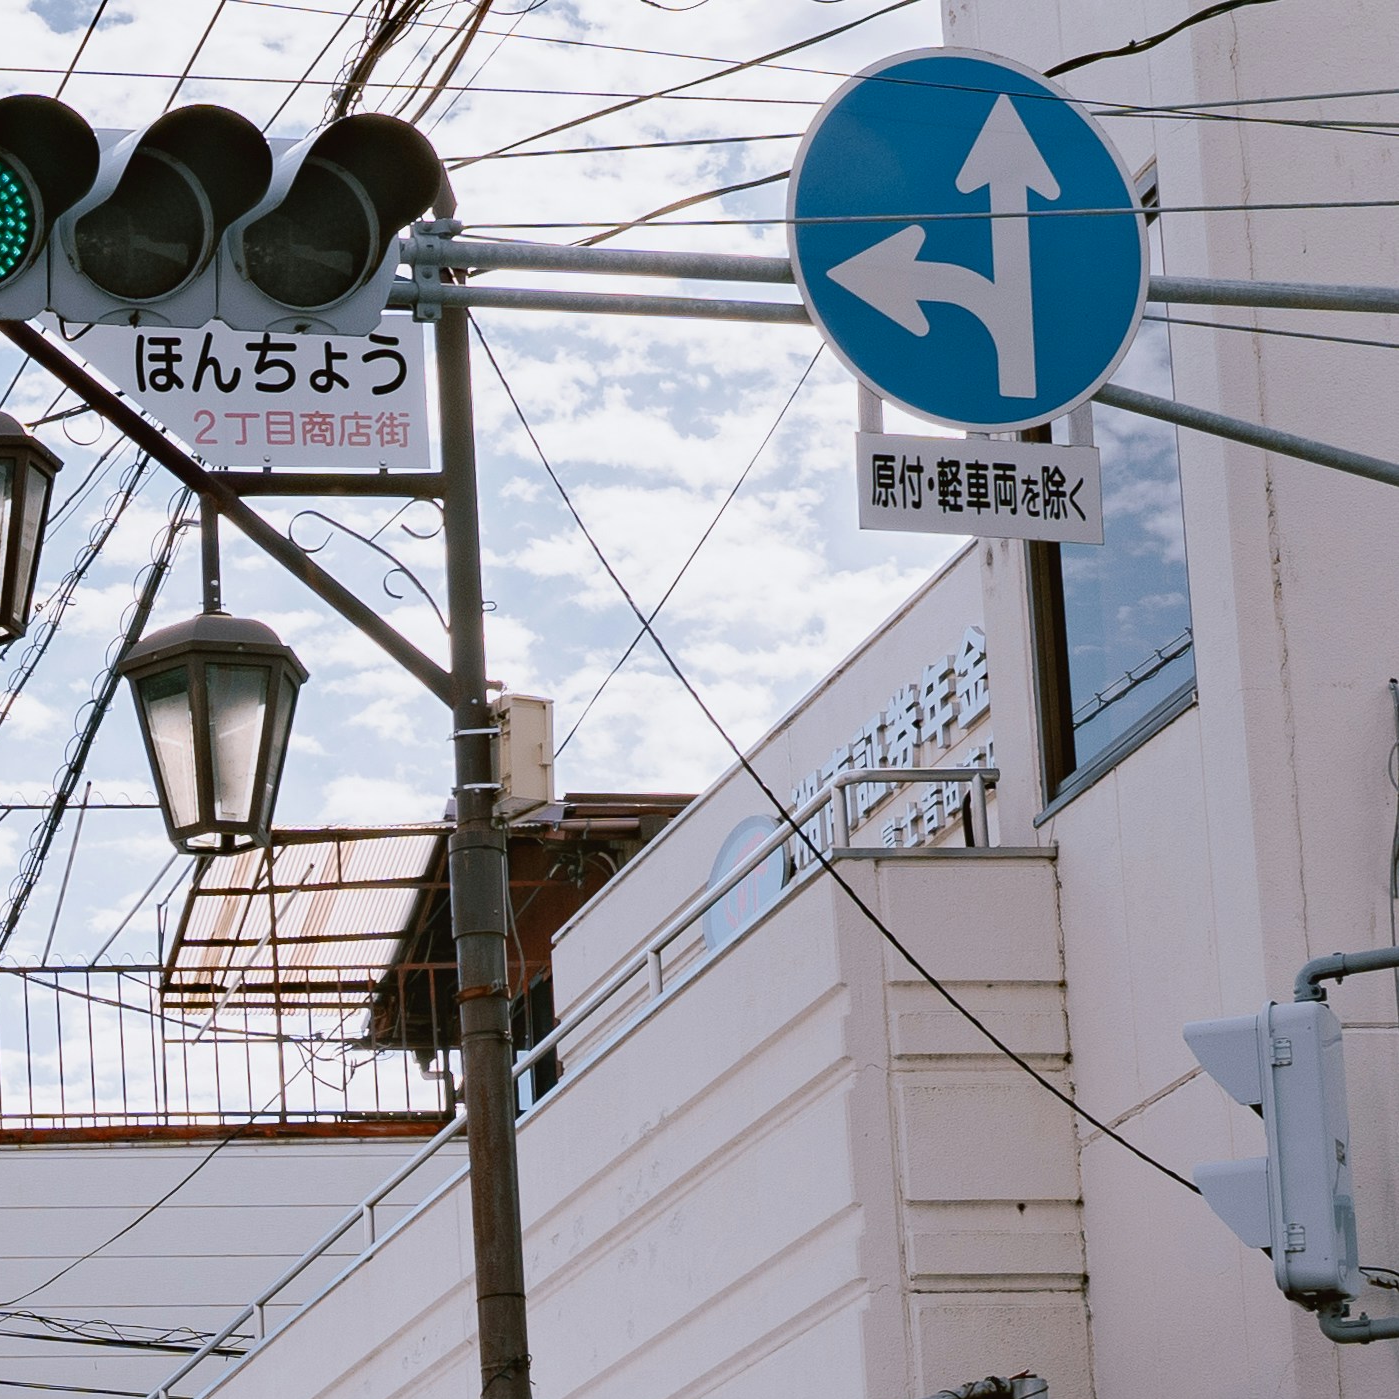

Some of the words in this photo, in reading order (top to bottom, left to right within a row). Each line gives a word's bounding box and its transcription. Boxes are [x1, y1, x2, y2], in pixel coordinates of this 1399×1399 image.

[135, 332, 408, 396] ほんちょう
[194, 409, 410, 448] 2丁目商店街
[871, 453, 1087, 522] 原付・軽車両を除く
